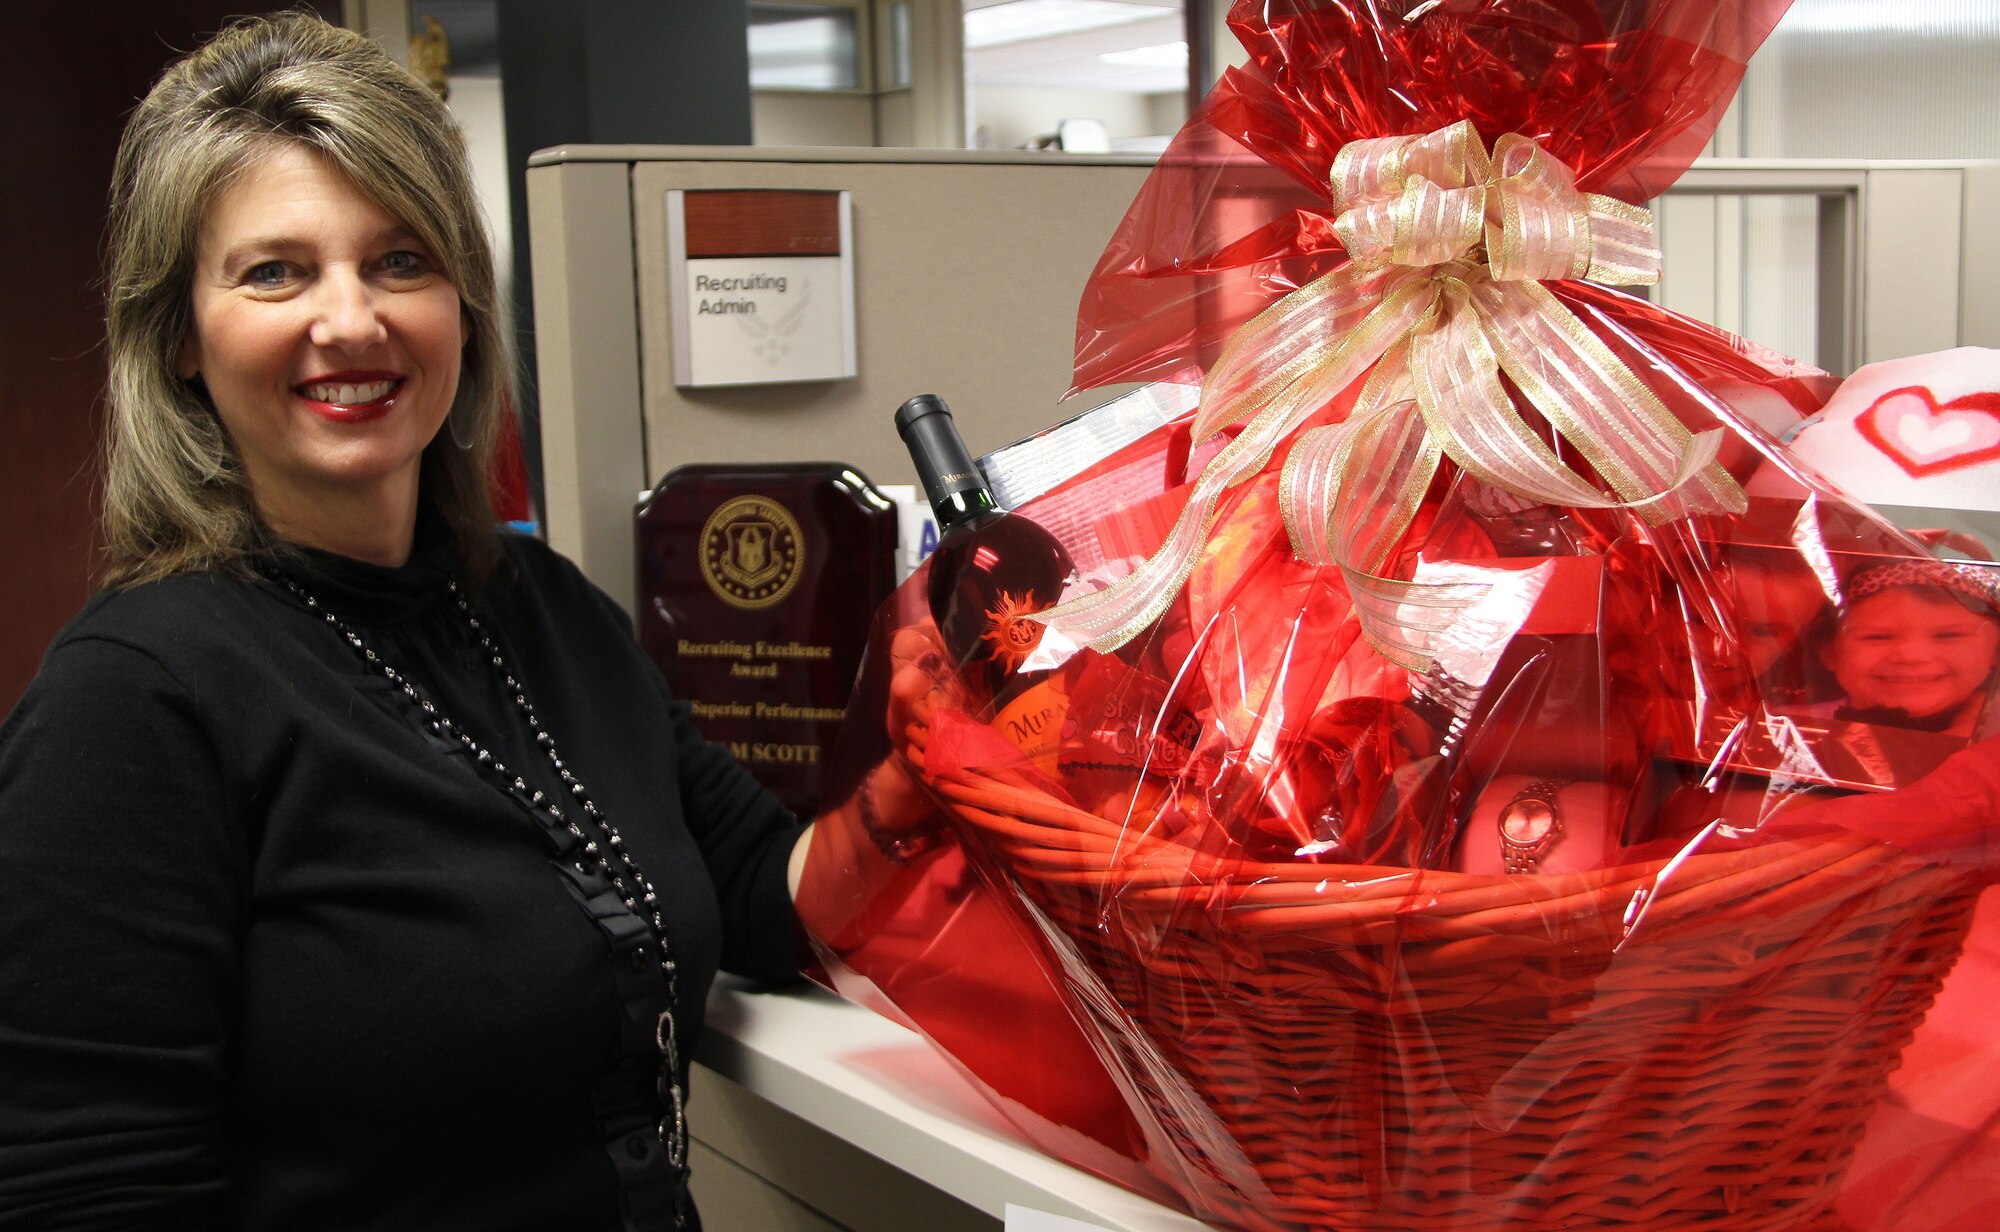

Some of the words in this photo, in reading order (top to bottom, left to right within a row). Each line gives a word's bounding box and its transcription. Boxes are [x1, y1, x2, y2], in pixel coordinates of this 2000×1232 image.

[696, 273, 787, 293] Recruiting
[698, 297, 756, 315] Admin
[677, 640, 751, 660] Recruiting
[755, 641, 832, 659] Excellence
[729, 662, 778, 679] Award
[691, 701, 751, 719] Superior
[755, 702, 846, 720] Performanc
[752, 743, 819, 762] SCOTT
